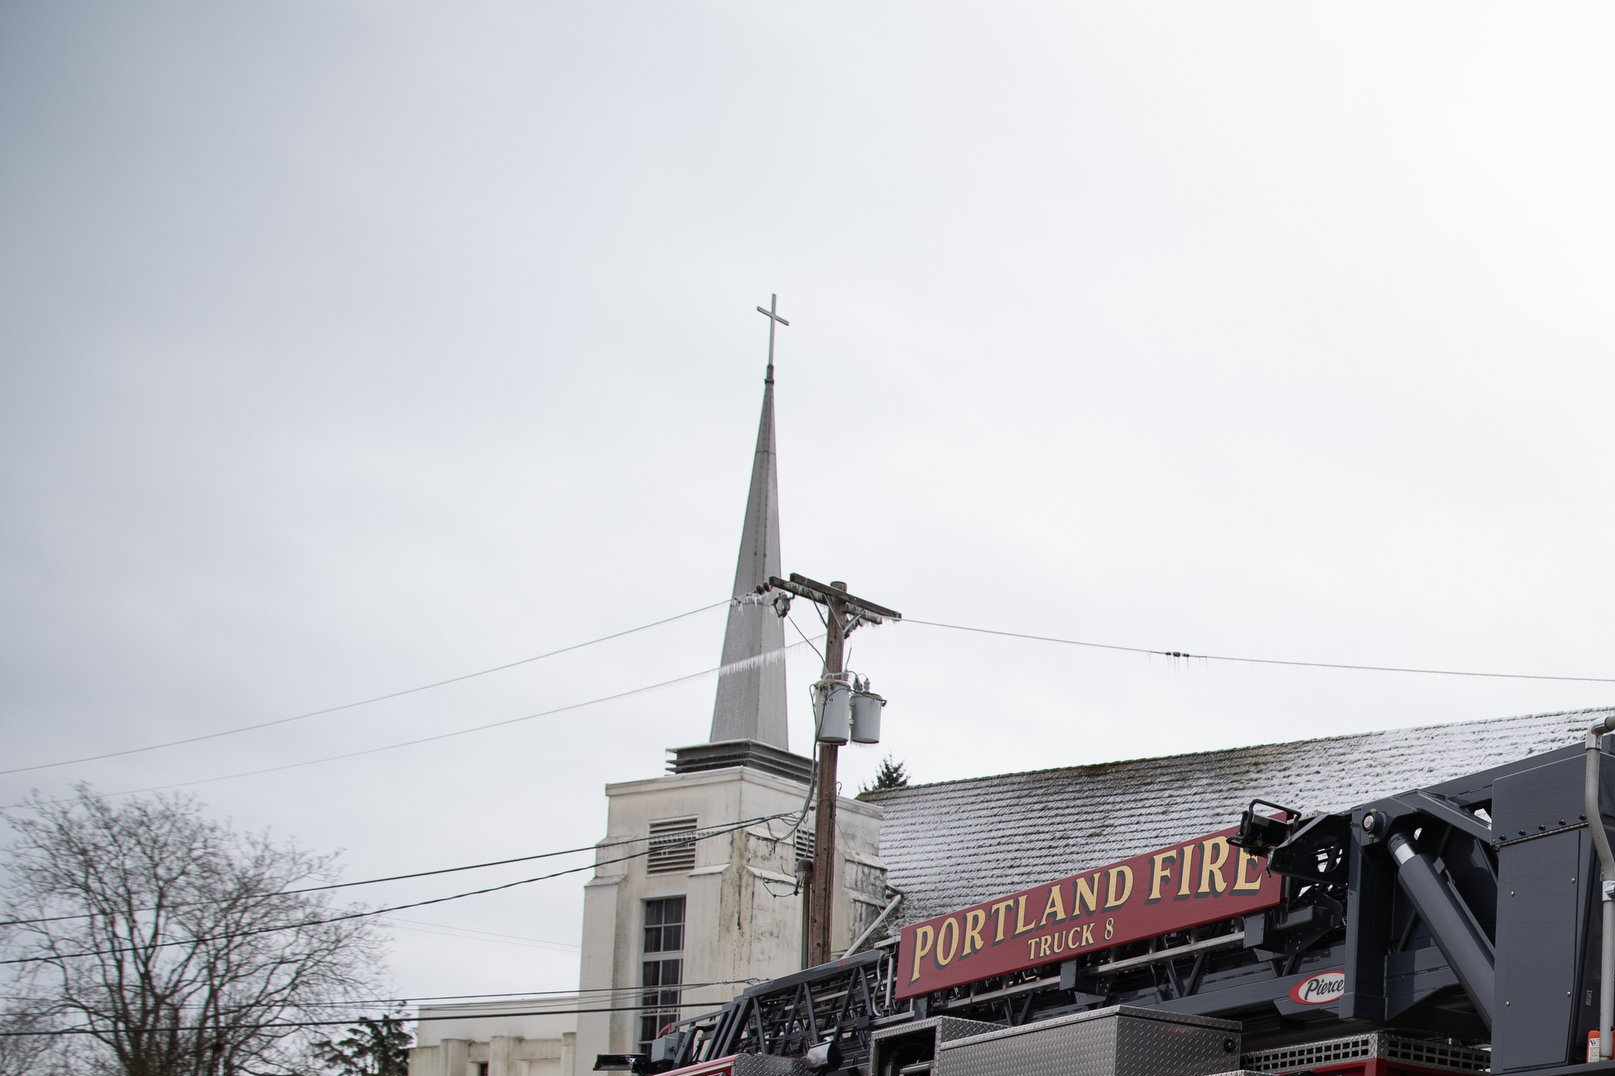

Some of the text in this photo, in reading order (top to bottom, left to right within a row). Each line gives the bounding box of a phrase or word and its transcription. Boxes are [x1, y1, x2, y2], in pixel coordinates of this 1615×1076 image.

[907, 834, 1263, 985] PORTLAND FIRE
[1027, 917, 1115, 960] TRUCK 8
[1304, 978, 1345, 1000] Pierce
